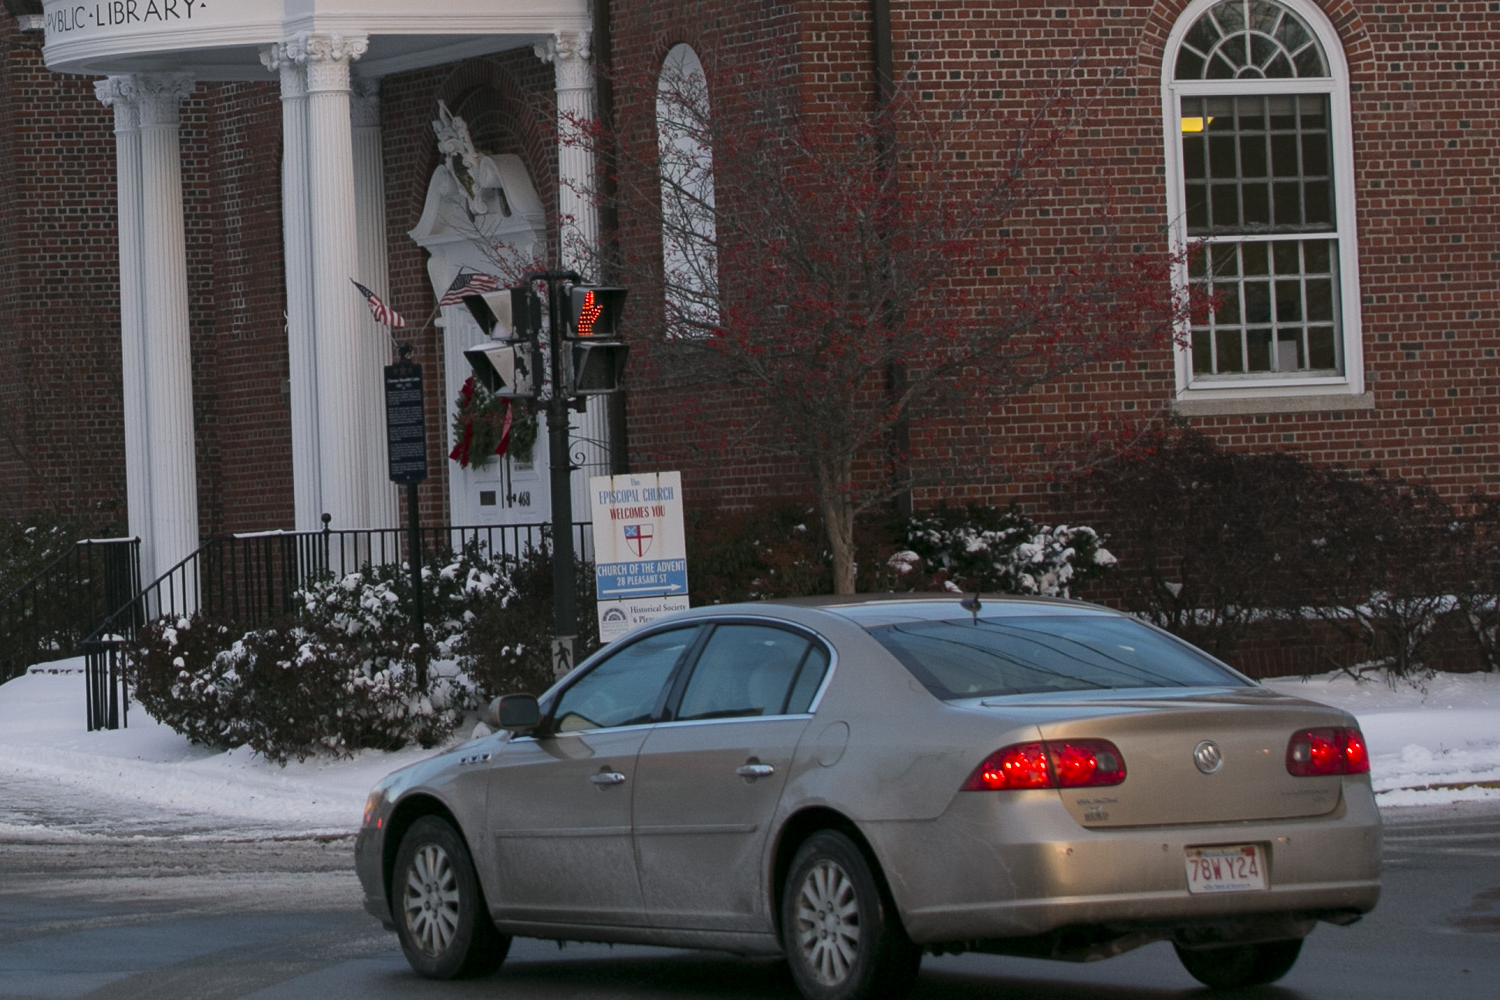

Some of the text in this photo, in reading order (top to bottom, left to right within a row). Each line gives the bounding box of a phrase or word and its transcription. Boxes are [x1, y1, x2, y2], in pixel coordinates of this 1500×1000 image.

[518, 491, 531, 507] 468
[599, 487, 674, 504] EPISCOPAL CHURCH
[610, 505, 665, 520] WELCOMES YOU
[597, 560, 685, 577] CHURCH OF THE ADVENT
[617, 574, 667, 586] 28 PLEASANT ST
[630, 604, 686, 614] Historical Society
[633, 616, 638, 624] 6
[1189, 855, 1258, 882] 78W Y24
